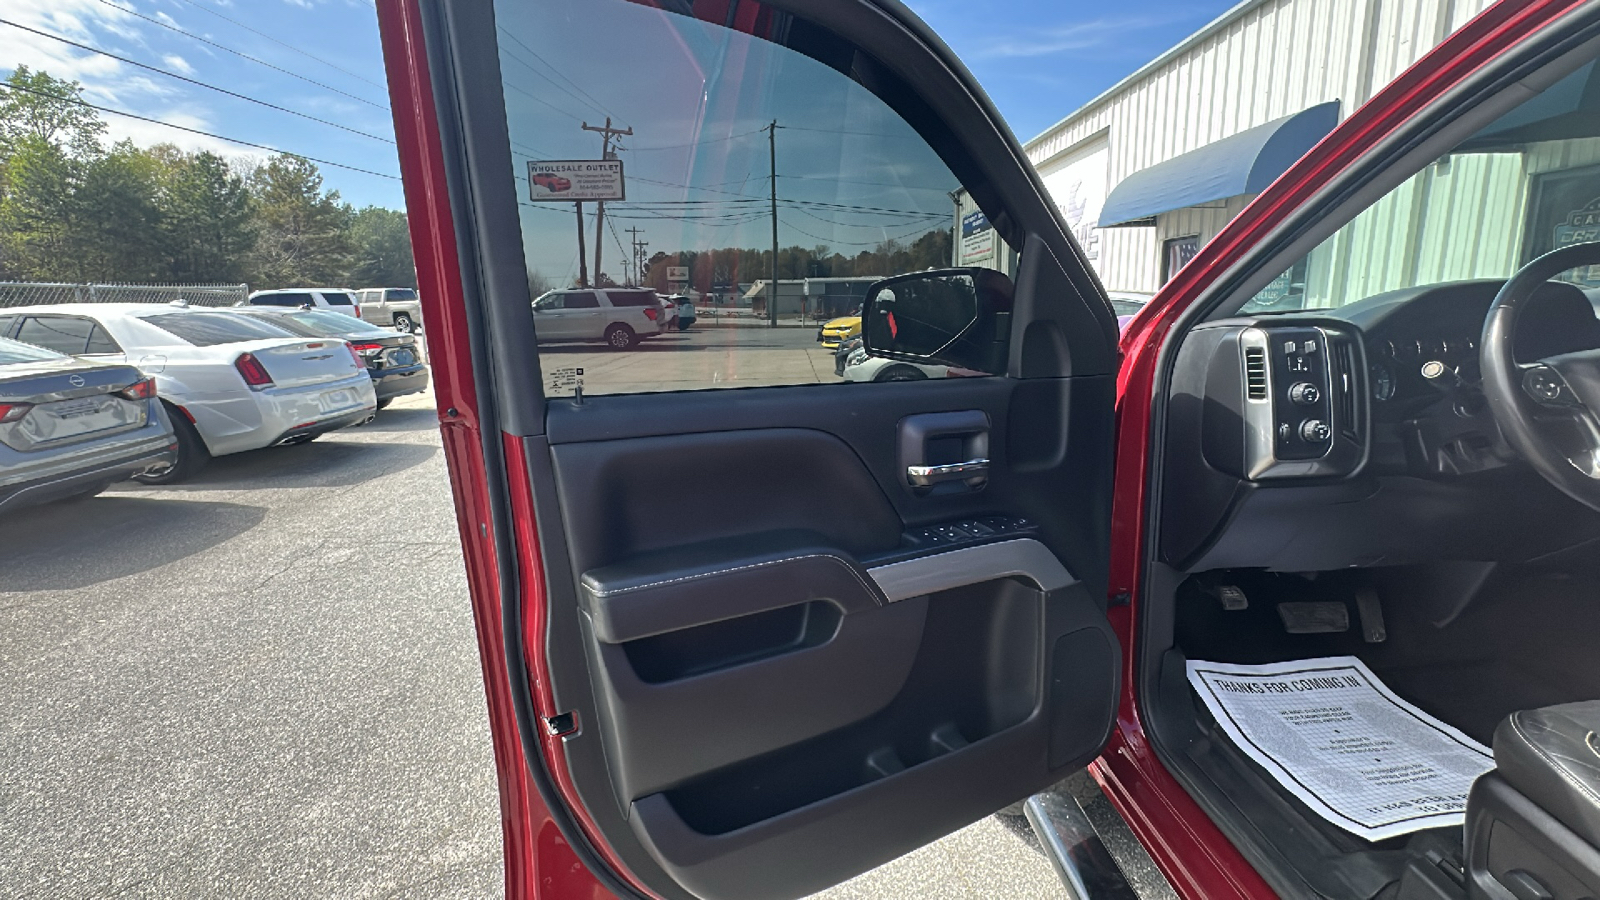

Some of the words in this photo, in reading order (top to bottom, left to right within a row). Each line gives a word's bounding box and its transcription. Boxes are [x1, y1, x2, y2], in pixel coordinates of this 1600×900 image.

[1213, 679, 1265, 694] THANKS
[1263, 682, 1294, 693] FOR
[1291, 676, 1346, 692] COMING
[1341, 675, 1363, 688] IN
